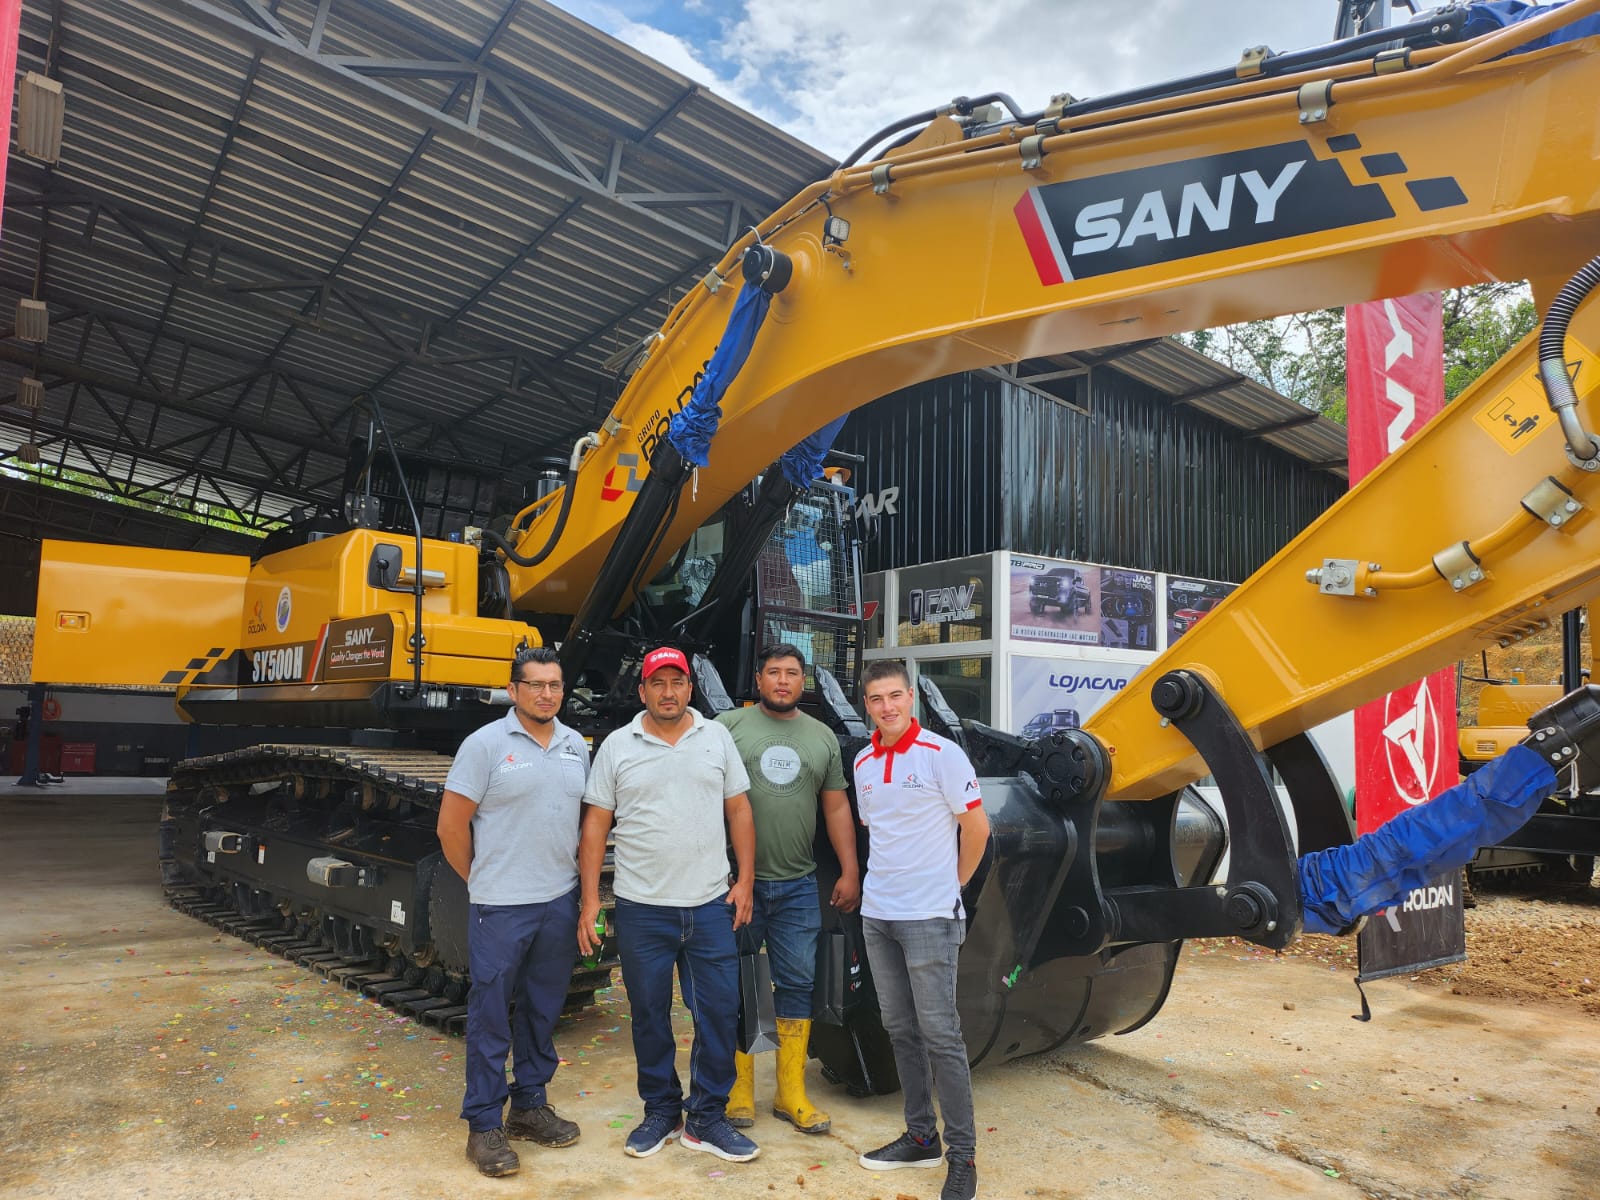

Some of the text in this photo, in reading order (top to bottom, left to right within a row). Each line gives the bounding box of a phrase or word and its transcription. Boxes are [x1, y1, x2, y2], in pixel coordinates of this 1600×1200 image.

[1071, 160, 1307, 256] SANY
[637, 409, 661, 443] GRUPO
[1133, 574, 1152, 585] JAC
[925, 584, 975, 613] FAW
[345, 627, 374, 647] SANY
[252, 646, 303, 682] SY500H
[1048, 674, 1128, 694] LOJACAR
[1403, 884, 1454, 913] ROLDAN
